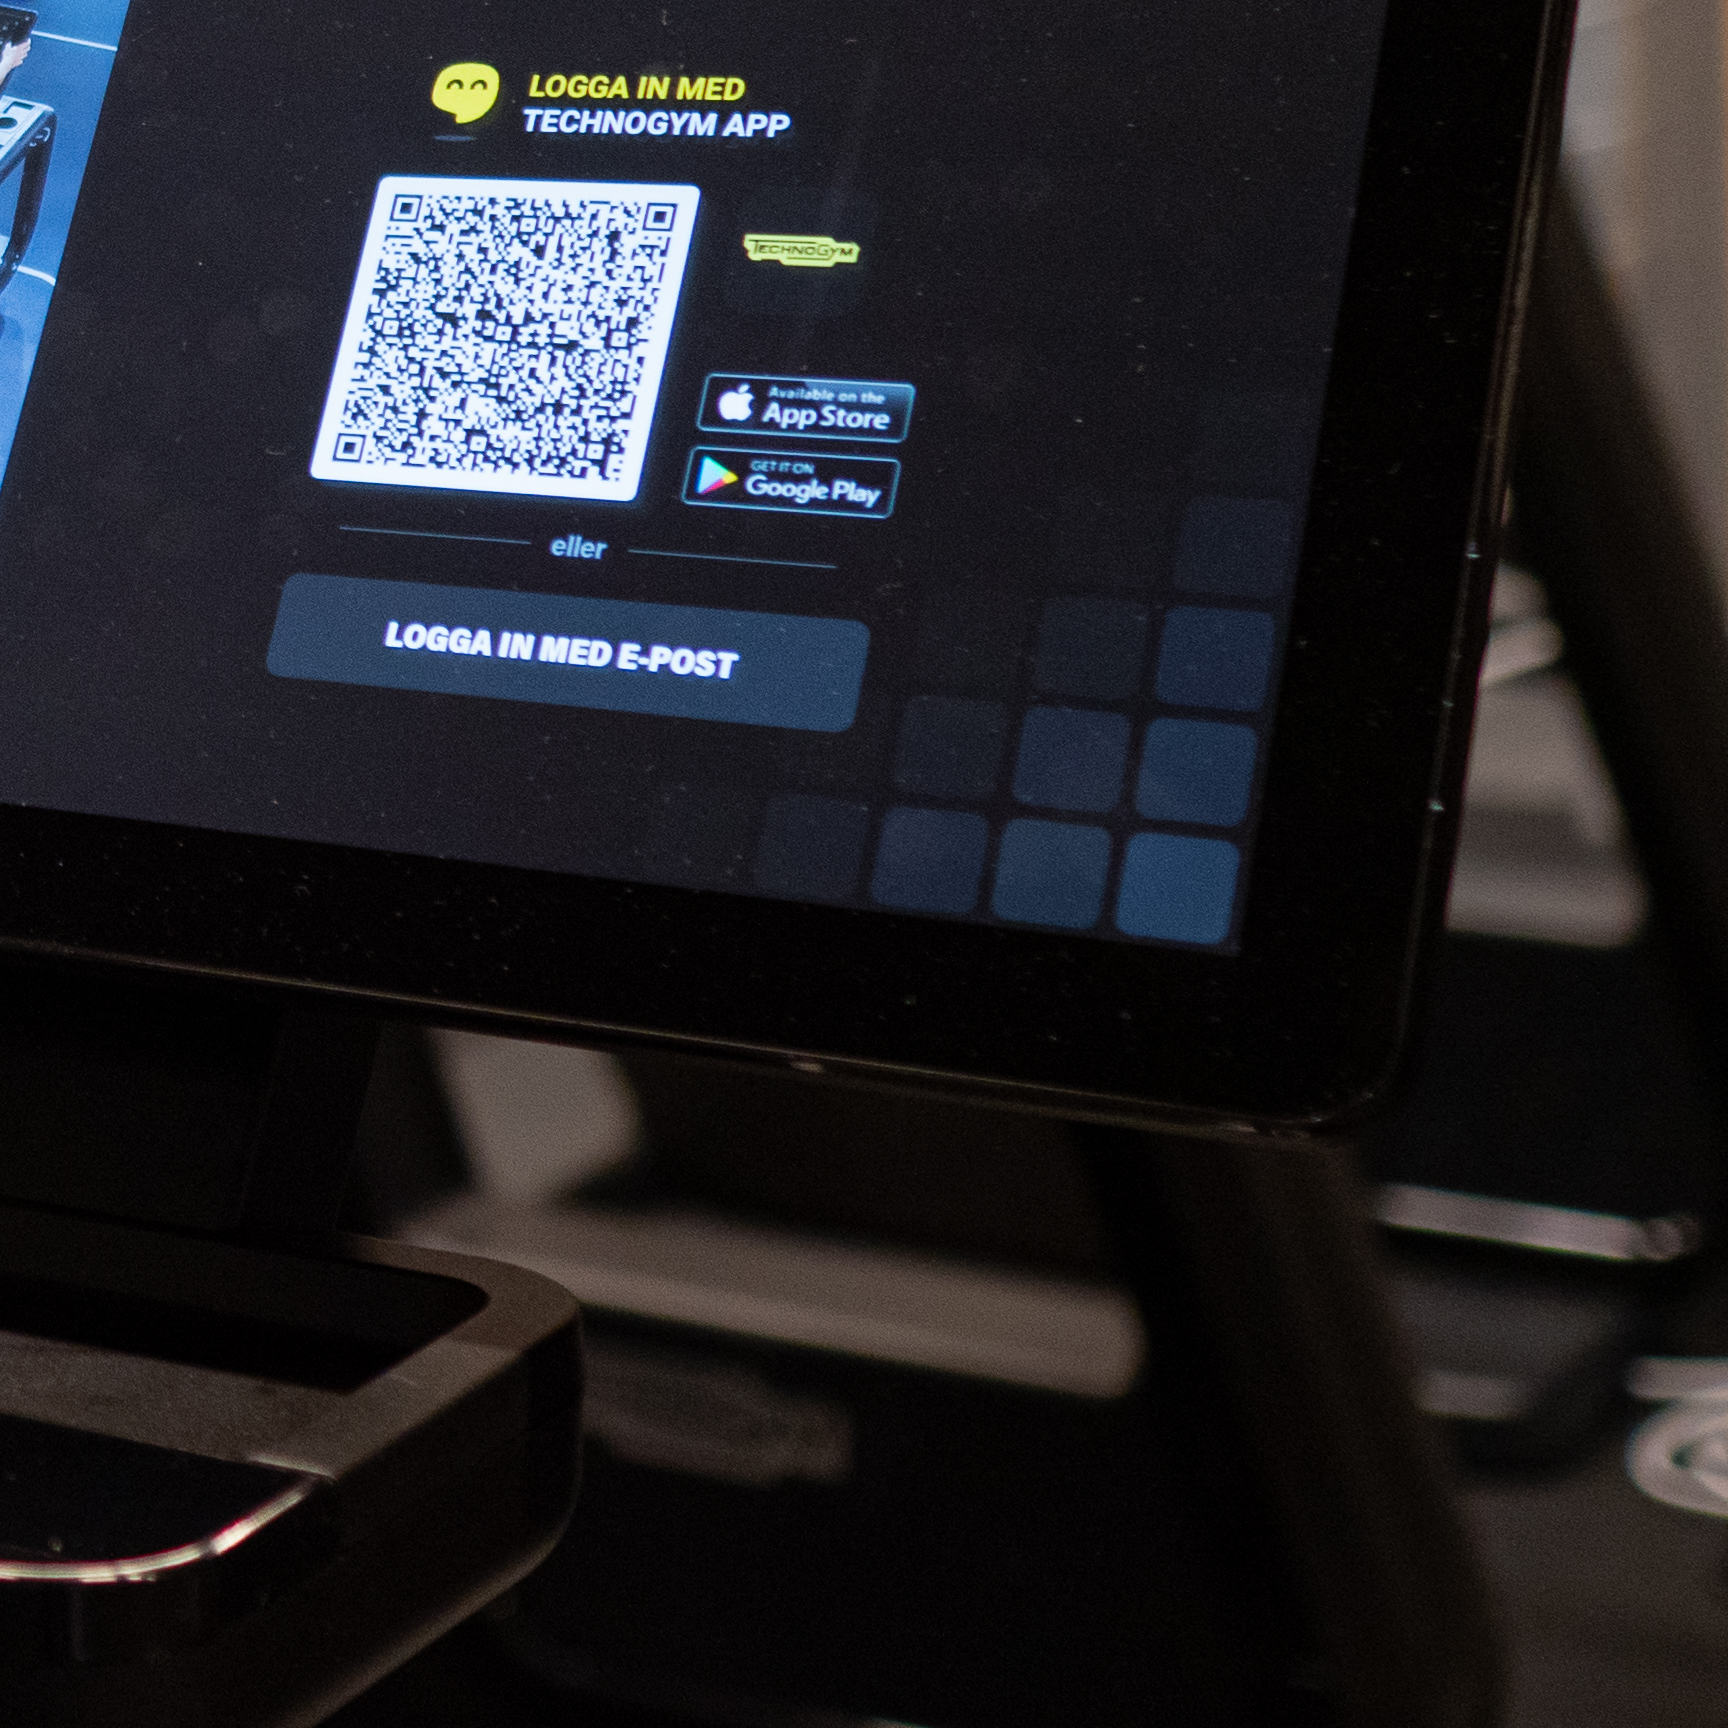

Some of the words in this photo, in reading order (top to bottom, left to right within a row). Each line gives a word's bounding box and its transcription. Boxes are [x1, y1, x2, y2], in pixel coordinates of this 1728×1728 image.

[528, 74, 630, 100] LOGGA
[636, 76, 671, 100] IN
[676, 76, 747, 102] MED
[522, 108, 719, 137] TECHNOGYM
[721, 111, 792, 139] APP
[767, 384, 835, 402] Available
[836, 392, 858, 403] on
[859, 391, 886, 405] the
[761, 401, 818, 431] App
[819, 403, 892, 431] Store
[750, 459, 778, 473] GET
[778, 460, 792, 473] IT
[792, 462, 815, 475] ON
[744, 474, 830, 504] Google
[831, 477, 883, 509] Play
[549, 534, 609, 560] eller
[384, 620, 493, 658] LOGGA
[497, 630, 536, 661] IN
[537, 633, 614, 668] MED
[616, 640, 741, 680] E-POST
